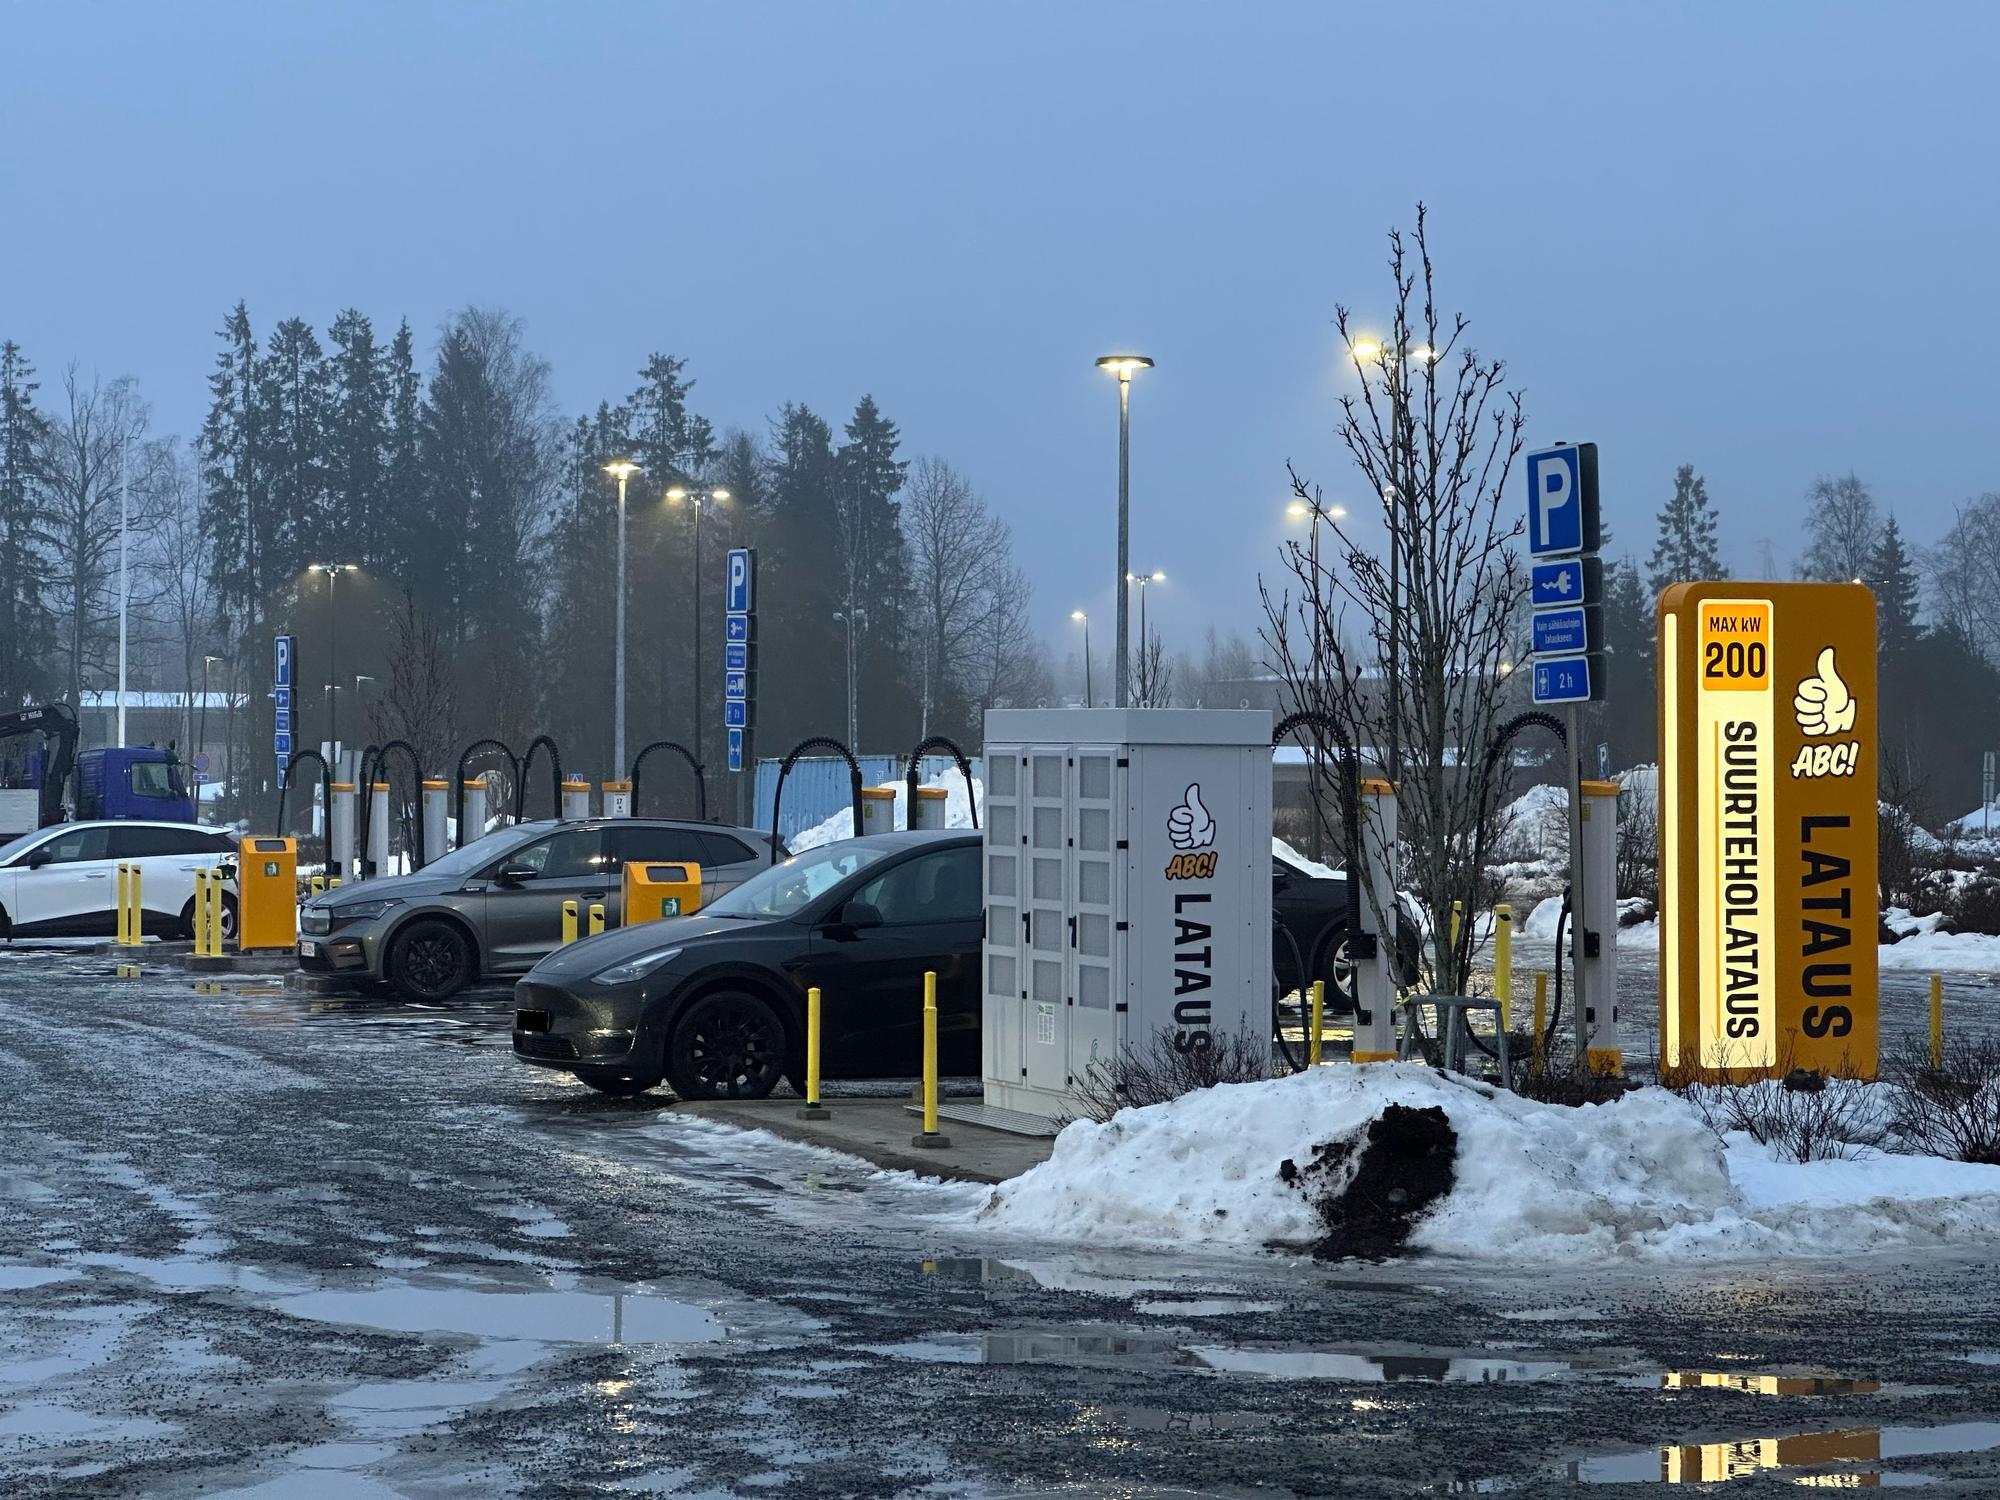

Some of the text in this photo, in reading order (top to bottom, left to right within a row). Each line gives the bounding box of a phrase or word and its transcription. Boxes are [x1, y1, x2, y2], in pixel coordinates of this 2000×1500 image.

[1537, 457, 1572, 546] P
[731, 555, 745, 608] P
[1709, 617, 1761, 633] MAX kW
[277, 641, 287, 682] P
[1705, 641, 1766, 678] 200
[1559, 672, 1573, 689] 2 h
[1600, 746, 1607, 774] P
[1791, 740, 1860, 779] ABC!
[1165, 851, 1218, 880] ABC!
[1724, 720, 1760, 1038] SUURTEHOLATAUS
[1801, 815, 1853, 1038] LATAUS
[1174, 893, 1212, 1054] LATAUS
